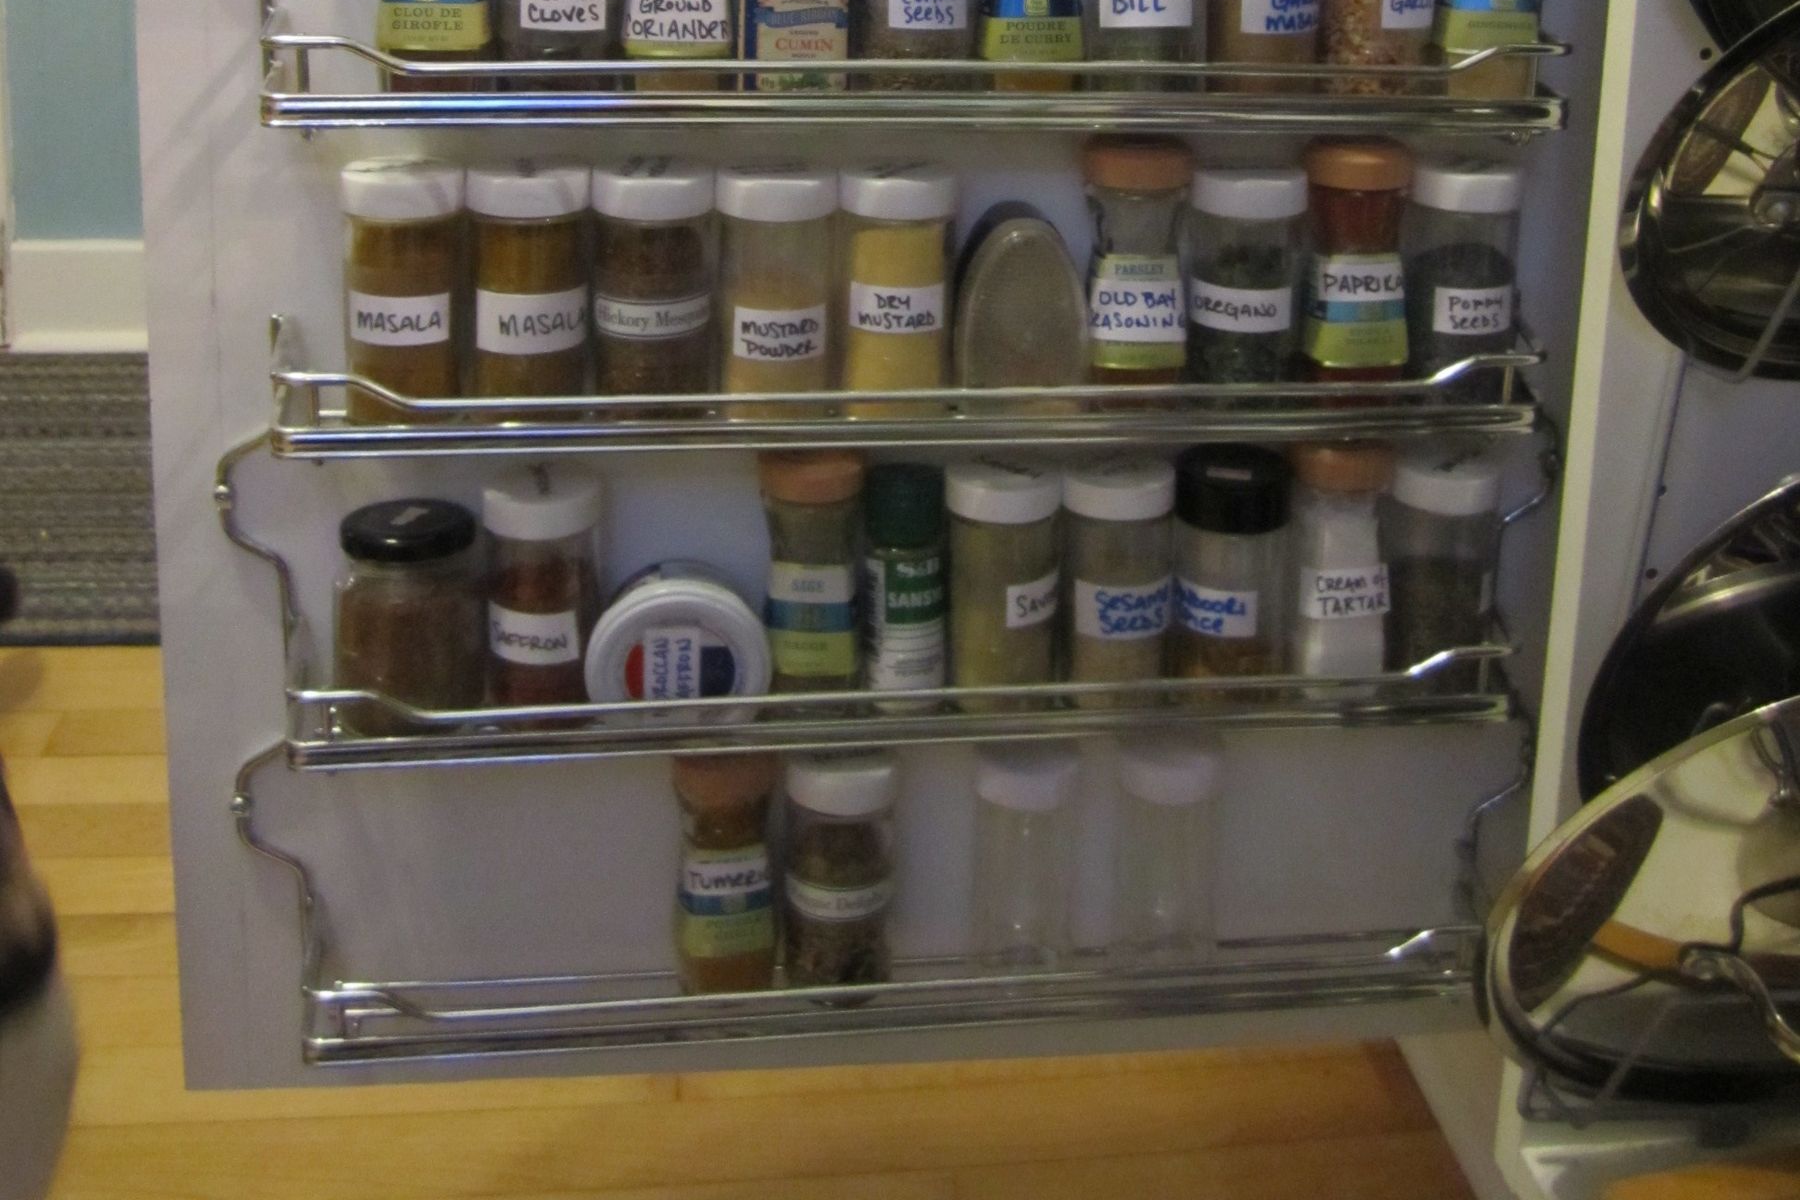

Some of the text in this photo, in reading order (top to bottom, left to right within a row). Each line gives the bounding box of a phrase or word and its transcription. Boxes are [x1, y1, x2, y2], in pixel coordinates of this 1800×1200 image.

[392, 7, 462, 19] CLOU DE
[527, 3, 600, 24] CLOVES
[391, 20, 464, 31] GIROFLE
[1006, 20, 1067, 32] POUDRE
[774, 38, 835, 52] CUMIN
[999, 33, 1072, 45] DE CURRY
[873, 292, 912, 311] DRY
[1099, 288, 1177, 308] OLD BAY
[357, 309, 442, 334] MASALA
[740, 318, 820, 340] MUSTARD
[858, 311, 936, 330] MUSTARD
[740, 338, 818, 358] POWDER
